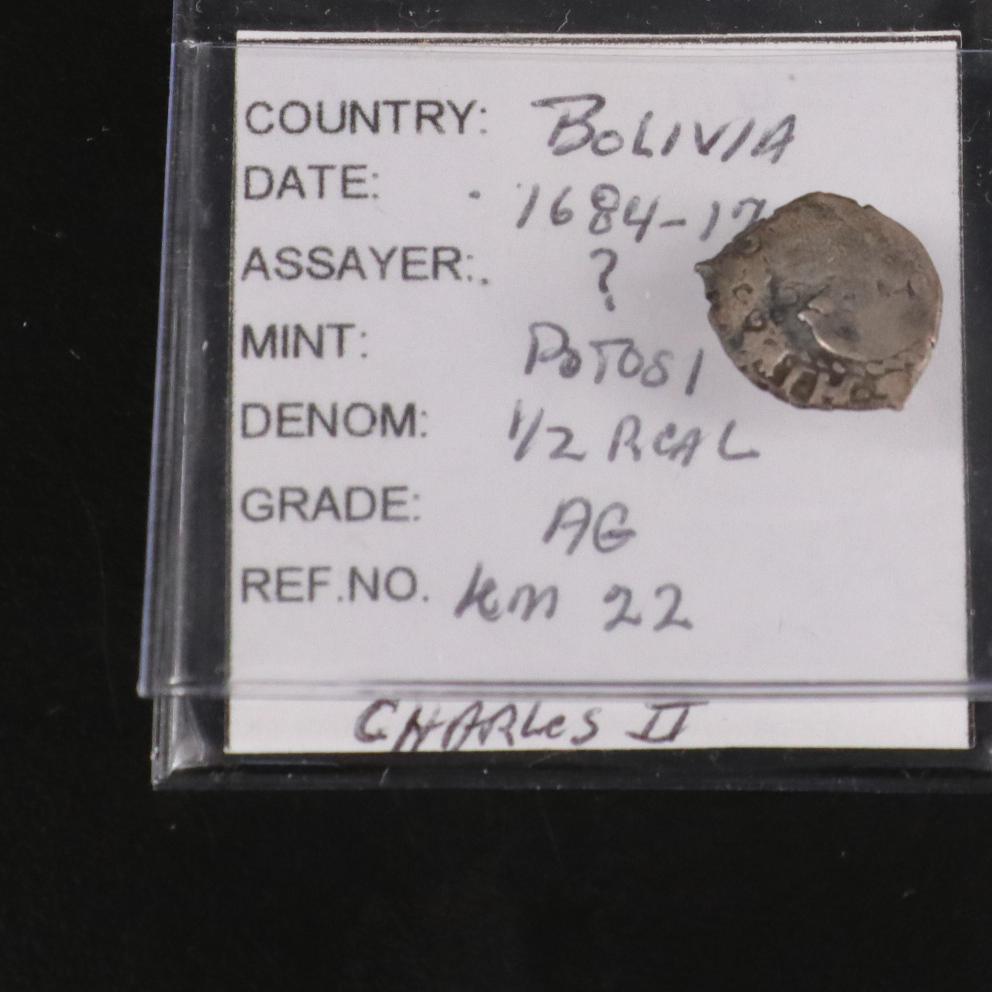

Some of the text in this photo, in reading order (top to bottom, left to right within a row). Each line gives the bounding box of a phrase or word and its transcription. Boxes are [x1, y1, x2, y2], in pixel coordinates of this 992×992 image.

[244, 99, 487, 136] COUNTRY:
[243, 163, 379, 201] DATE:
[514, 182, 767, 243] 1684-17
[240, 245, 474, 283] ASSAYER:
[590, 247, 618, 312] ?
[240, 322, 367, 360] MINT:
[240, 401, 427, 439] DENOM:
[507, 399, 587, 462] 1/2
[240, 485, 421, 523] GRADE:
[542, 497, 637, 556] AG
[241, 566, 429, 603] REF.NO.
[603, 583, 693, 632] 22
